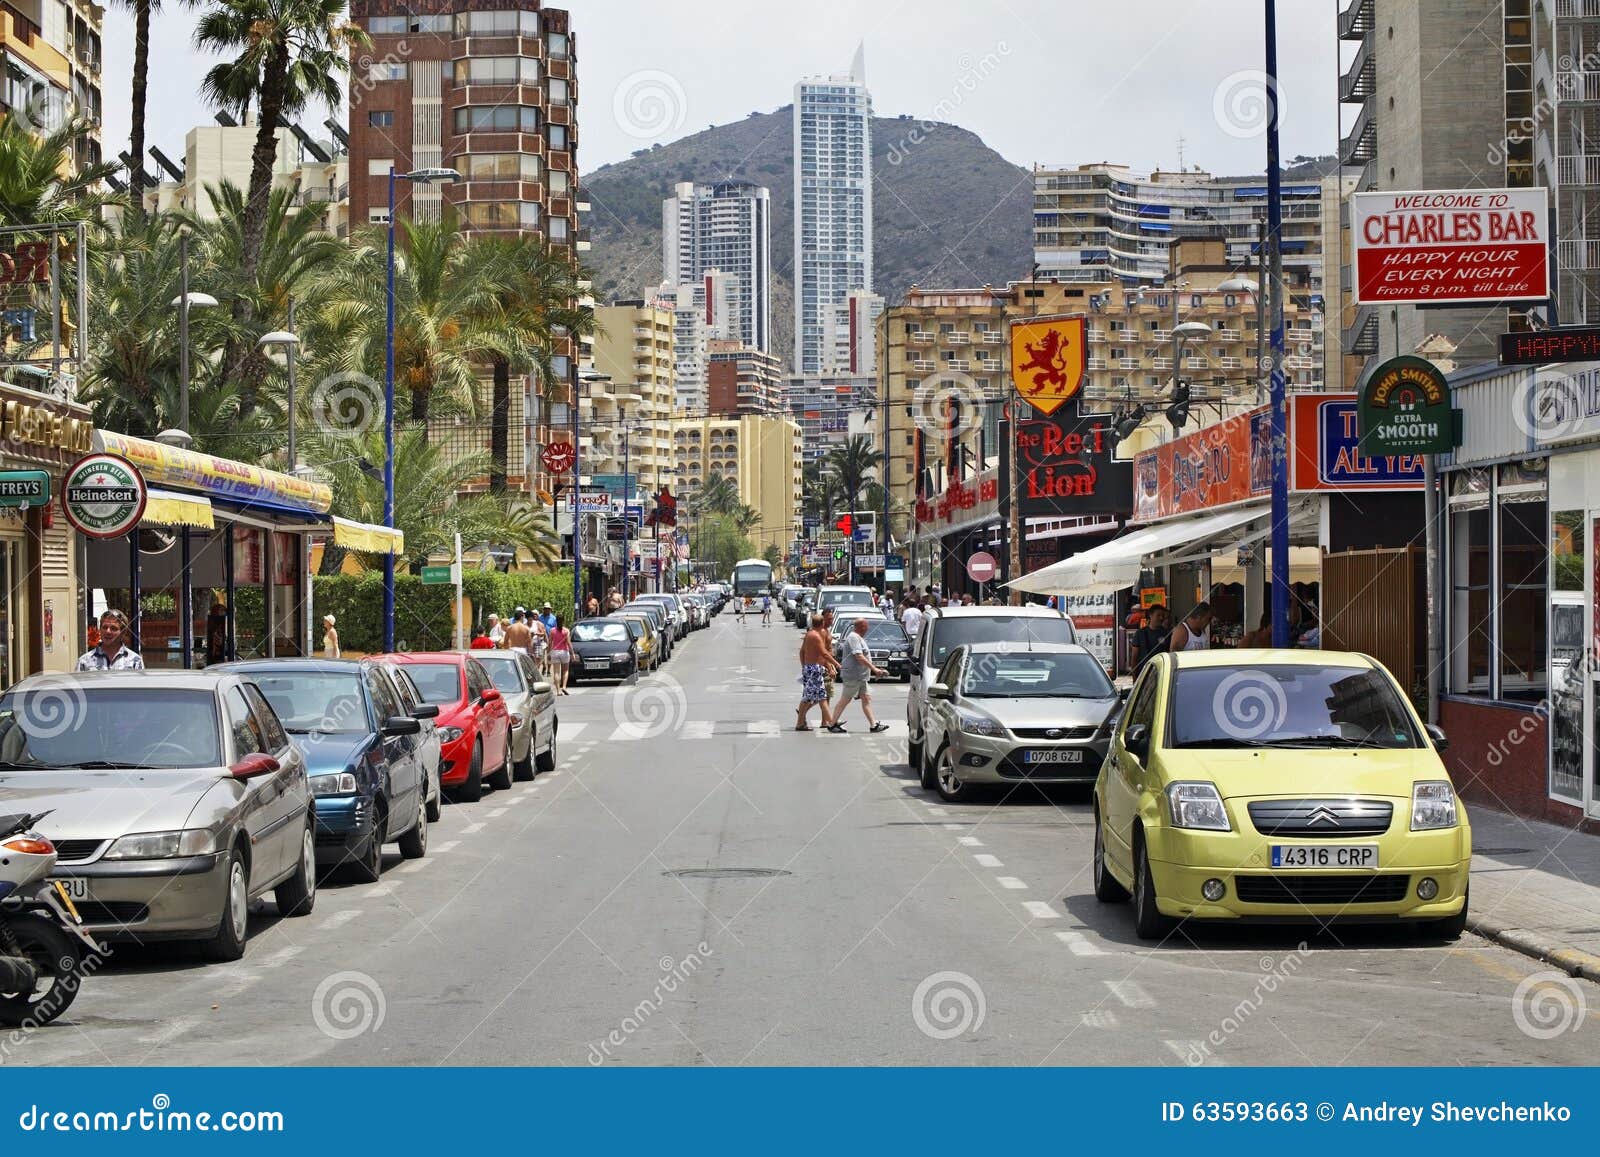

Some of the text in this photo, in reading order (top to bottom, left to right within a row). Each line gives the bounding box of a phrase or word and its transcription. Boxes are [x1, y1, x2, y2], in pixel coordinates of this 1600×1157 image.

[1394, 194, 1509, 209] WELCOME TO
[1363, 210, 1539, 245] CHARLES BAR
[1383, 250, 1519, 265] HAPPY HOUR
[1384, 266, 1520, 282] EVERY NIGHT
[1376, 281, 1529, 296] From 8 p.m. till Late
[1374, 368, 1440, 403] JOHN SMITH'S
[1394, 414, 1422, 424] EXTRA
[1377, 423, 1439, 439] SMOOTH
[1333, 446, 1425, 474] ALL YEA
[78, 464, 125, 480] HEINEKEN BEER
[1027, 466, 1096, 498] Lion
[72, 489, 132, 501] Heineken
[1031, 751, 1080, 762] 0708 GZJ
[1285, 848, 1329, 865] 4316
[1337, 848, 1373, 865] CRP
